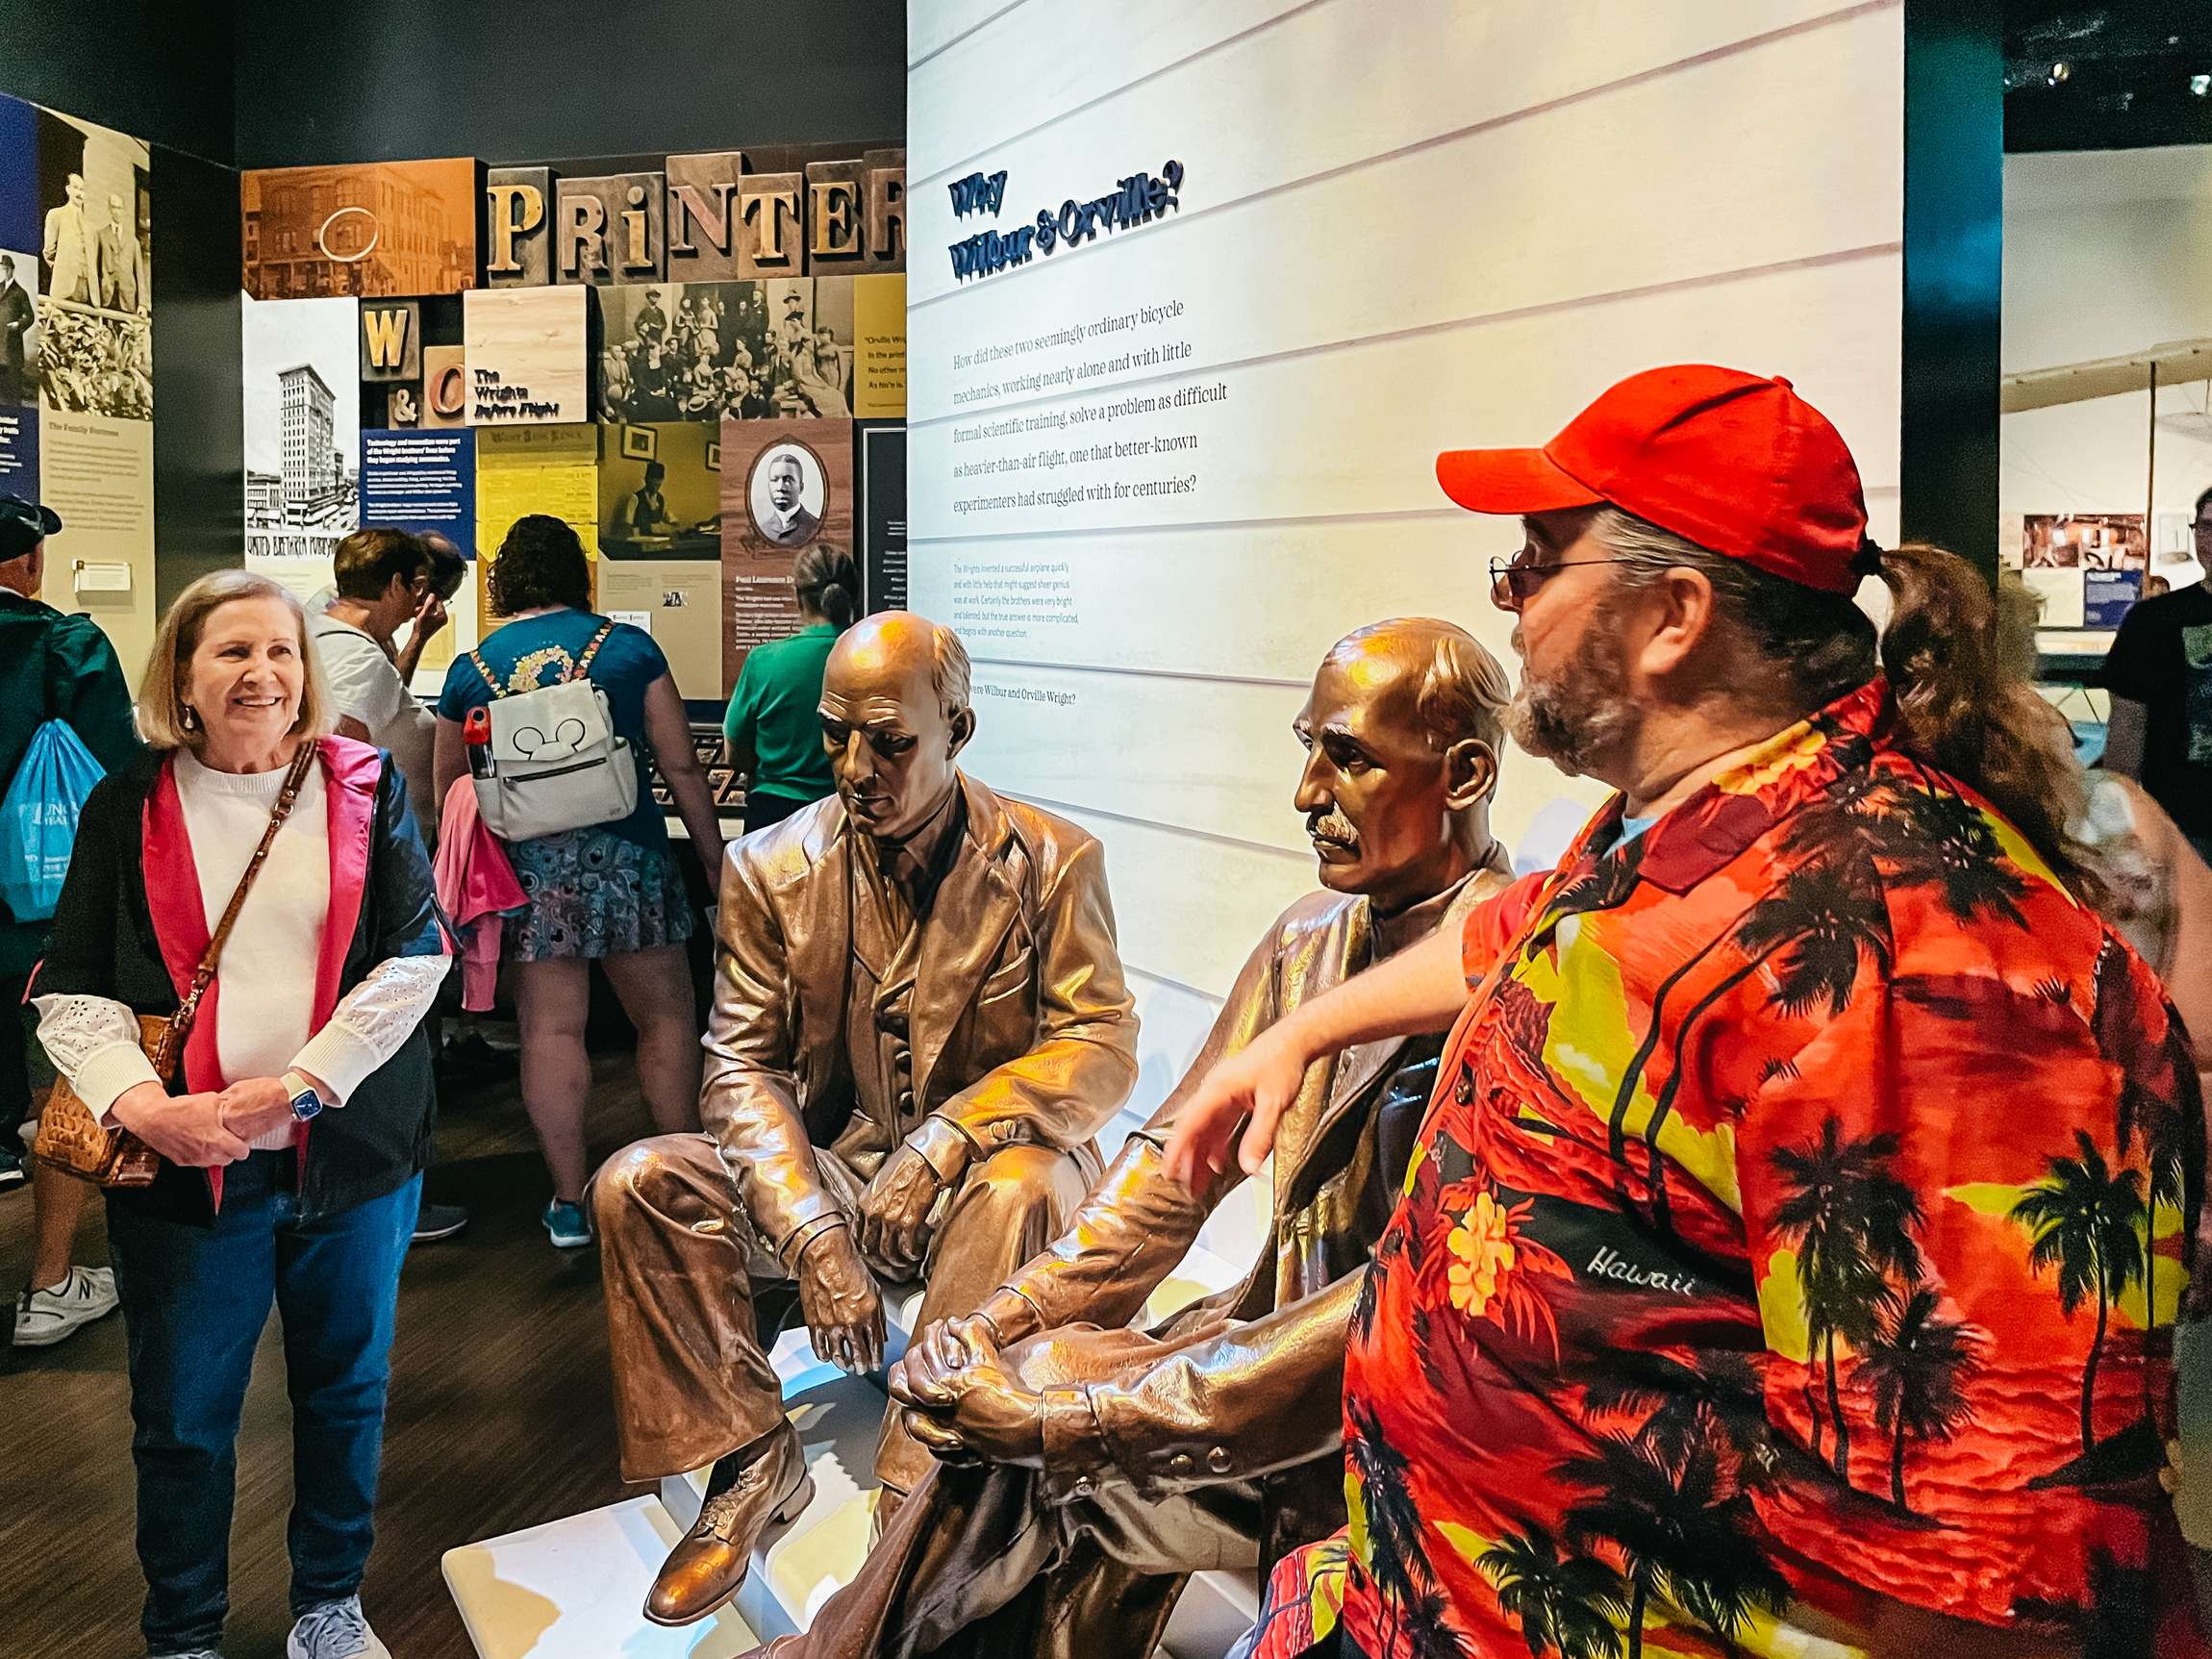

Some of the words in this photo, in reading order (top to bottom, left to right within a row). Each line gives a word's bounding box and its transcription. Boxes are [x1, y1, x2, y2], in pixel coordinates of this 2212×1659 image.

[947, 170, 1008, 223] Why
[948, 225, 1035, 284] Wilbur
[1036, 209, 1058, 256] &
[1058, 160, 1185, 248] Orville?
[364, 309, 409, 367] W
[953, 353, 972, 369] How
[973, 348, 989, 365] did
[990, 343, 1014, 363] these
[1015, 339, 1034, 355] two
[1035, 325, 1086, 350] seemingly
[1088, 312, 1139, 338] ordinary
[1140, 300, 1184, 324] bicycle
[954, 385, 1001, 405] mechanics,
[1002, 373, 1042, 395] working
[1043, 368, 1075, 389] nearly
[1076, 361, 1106, 379] alone
[1108, 354, 1130, 371] and
[1132, 346, 1159, 367] with
[1161, 341, 1192, 363] little
[393, 389, 417, 421] &
[954, 425, 982, 443] formal
[983, 419, 1024, 440] scientific
[1025, 411, 1068, 433] training,
[1069, 405, 1097, 422] solve
[1098, 408, 1105, 419] a
[1107, 396, 1155, 421] problem
[1158, 398, 1171, 410] as
[1173, 383, 1228, 407] difficult
[954, 465, 963, 477] as
[964, 451, 1036, 476] heavier-than-air
[1039, 447, 1068, 469] flight,
[1069, 449, 1090, 464] one
[1091, 443, 1113, 461] that
[1115, 434, 1198, 459] better-known
[953, 493, 1016, 515] experimenters
[1018, 490, 1036, 508] had
[1037, 485, 1085, 507] struggled
[1086, 481, 1111, 500] with
[1113, 481, 1131, 499] for
[1132, 474, 1196, 497] centuries?
[985, 685, 1007, 697] Wilbur
[1008, 689, 1020, 698] and
[1021, 689, 1045, 701] Orville
[1046, 691, 1076, 706] Wright?
[1587, 1245, 1696, 1296] Hawaii
